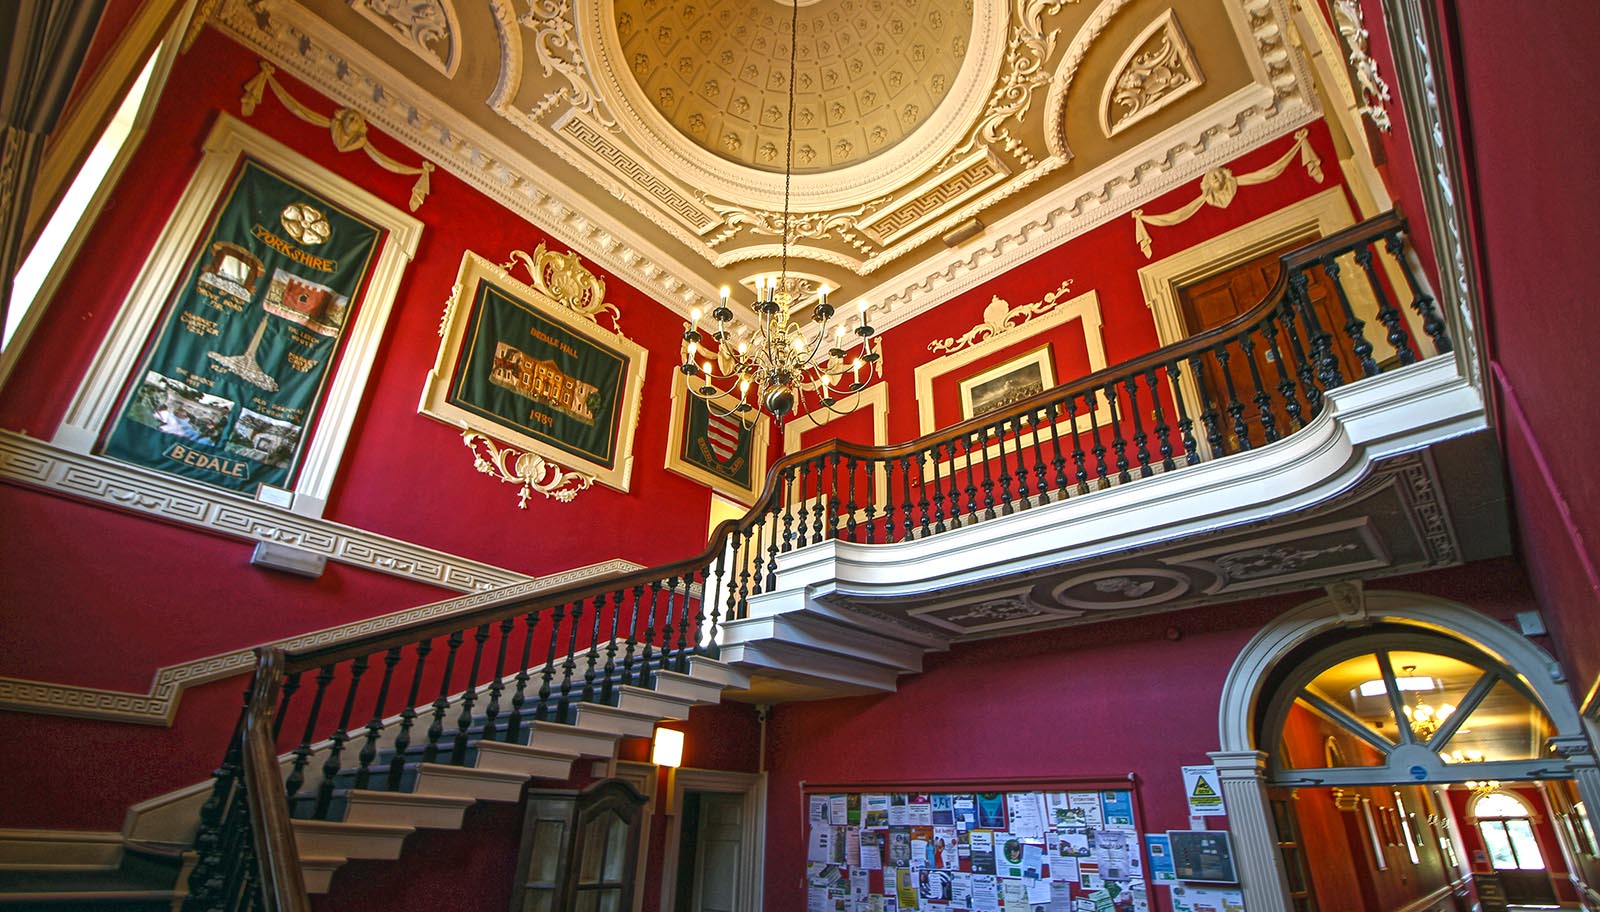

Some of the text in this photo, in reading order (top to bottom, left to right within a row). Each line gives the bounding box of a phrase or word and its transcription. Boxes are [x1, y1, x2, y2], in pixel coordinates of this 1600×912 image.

[256, 223, 333, 273] YORKSHIRE
[559, 342, 579, 359] HALL
[529, 409, 553, 428] 1989
[170, 445, 246, 477] BEDALE
